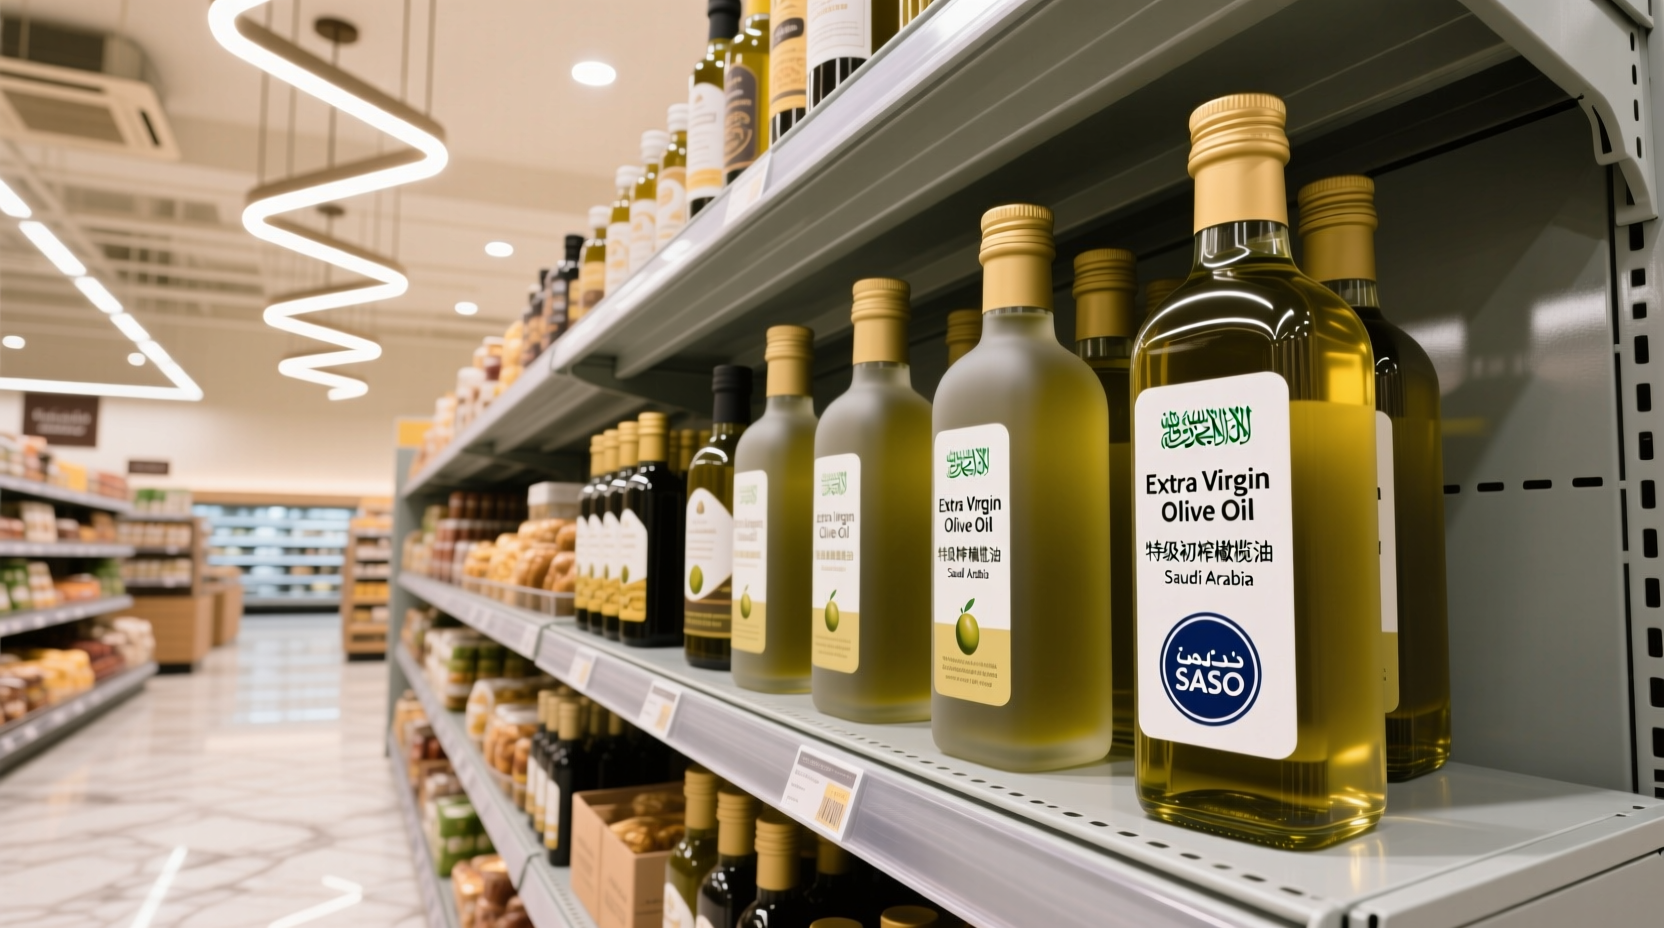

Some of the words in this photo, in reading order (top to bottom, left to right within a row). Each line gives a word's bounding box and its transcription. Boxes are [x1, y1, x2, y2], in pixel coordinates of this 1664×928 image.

[1146, 474, 1198, 495] Extra
[1202, 467, 1270, 497] Virgin
[1161, 500, 1216, 522] Olive
[1221, 498, 1254, 521] Oil
[944, 516, 972, 533] Olive
[975, 514, 993, 533] Oil
[1164, 569, 1202, 585] Saudi
[1205, 569, 1254, 587] Arabia
[1175, 667, 1245, 697] SASO
